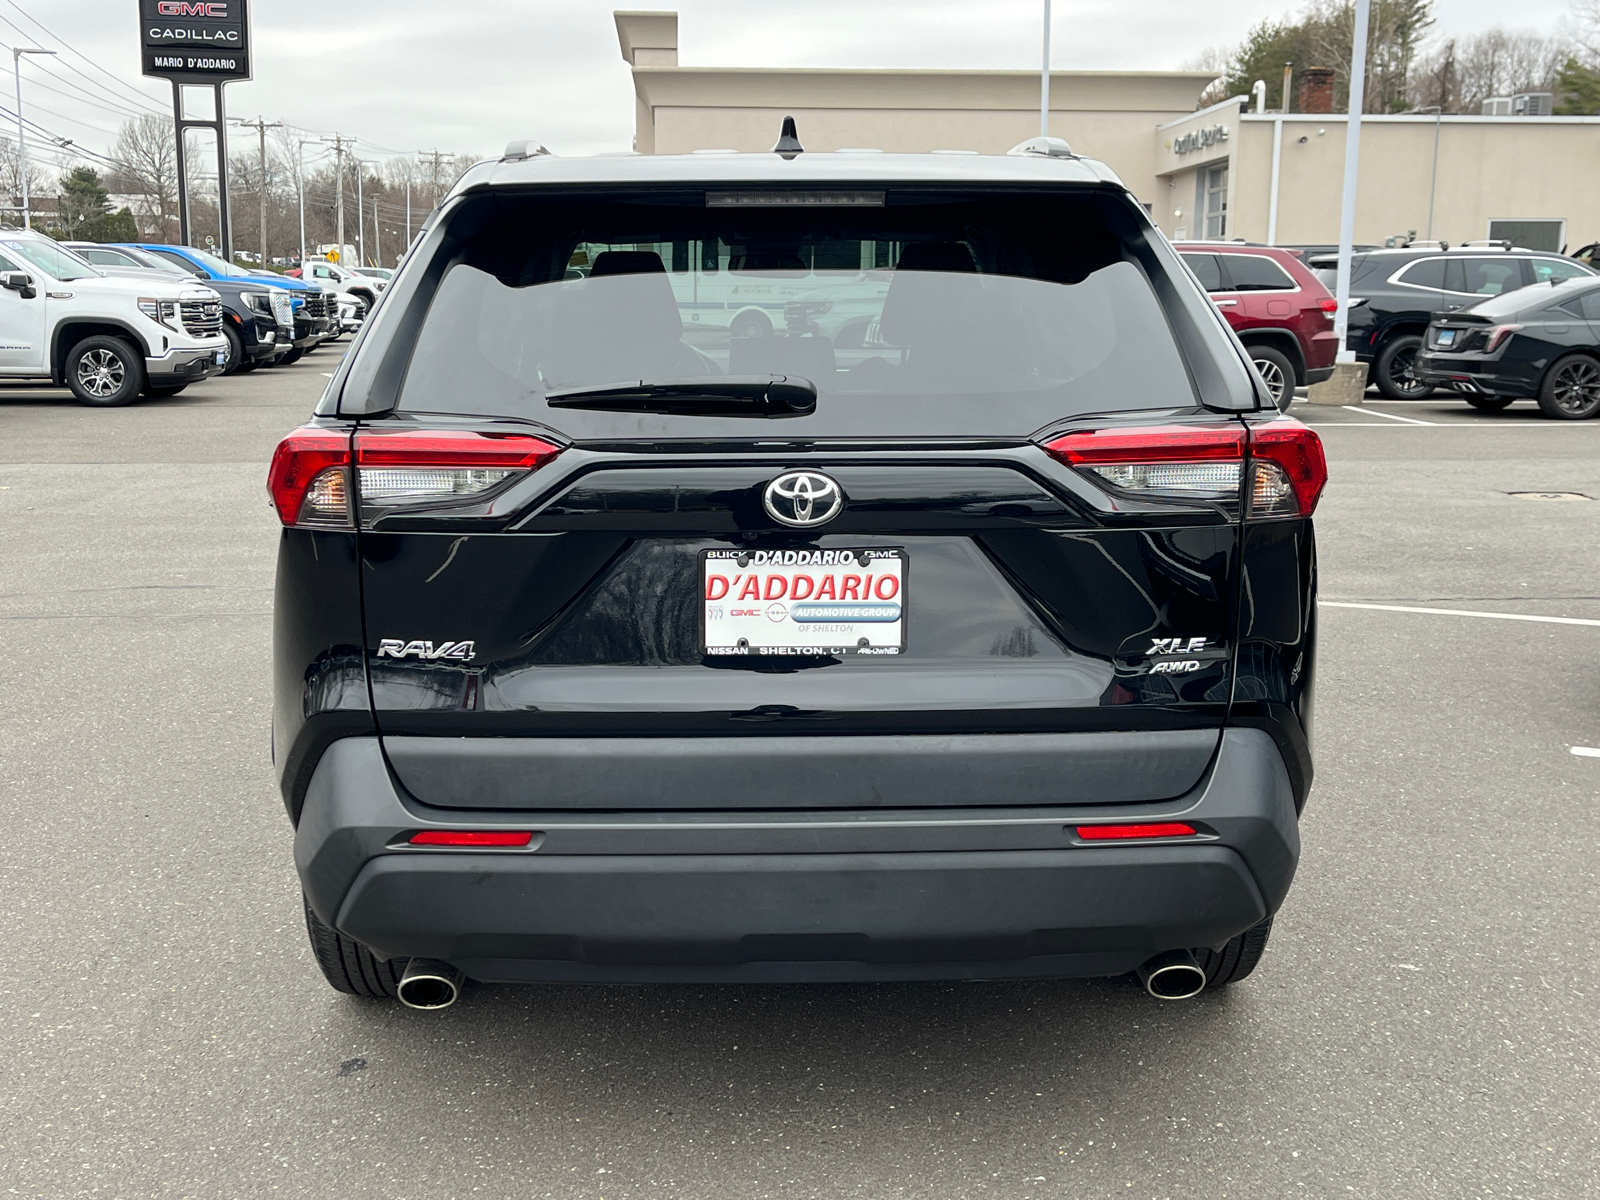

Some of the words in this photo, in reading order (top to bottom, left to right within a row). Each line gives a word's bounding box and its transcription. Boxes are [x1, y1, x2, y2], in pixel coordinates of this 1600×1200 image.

[158, 1, 228, 18] GMC
[149, 28, 239, 41] CADILLAC
[154, 56, 184, 68] MARIO
[187, 58, 236, 70] D'ADDARIO
[707, 551, 747, 559] BUICK
[753, 550, 854, 566] D'ADDARIO
[864, 550, 899, 558] GMC
[705, 574, 900, 601] D'ADDARIO
[730, 609, 761, 617] GMC
[796, 608, 860, 617] AUTOMOTIVE
[861, 608, 896, 617] GROUP
[798, 624, 811, 632] OF
[812, 624, 854, 632] SHELTON
[377, 639, 476, 661] RAV4
[707, 647, 748, 655] NISSAN
[759, 647, 827, 655] SHELTON,
[1145, 637, 1207, 655] XLE
[1149, 660, 1200, 675] AWD
